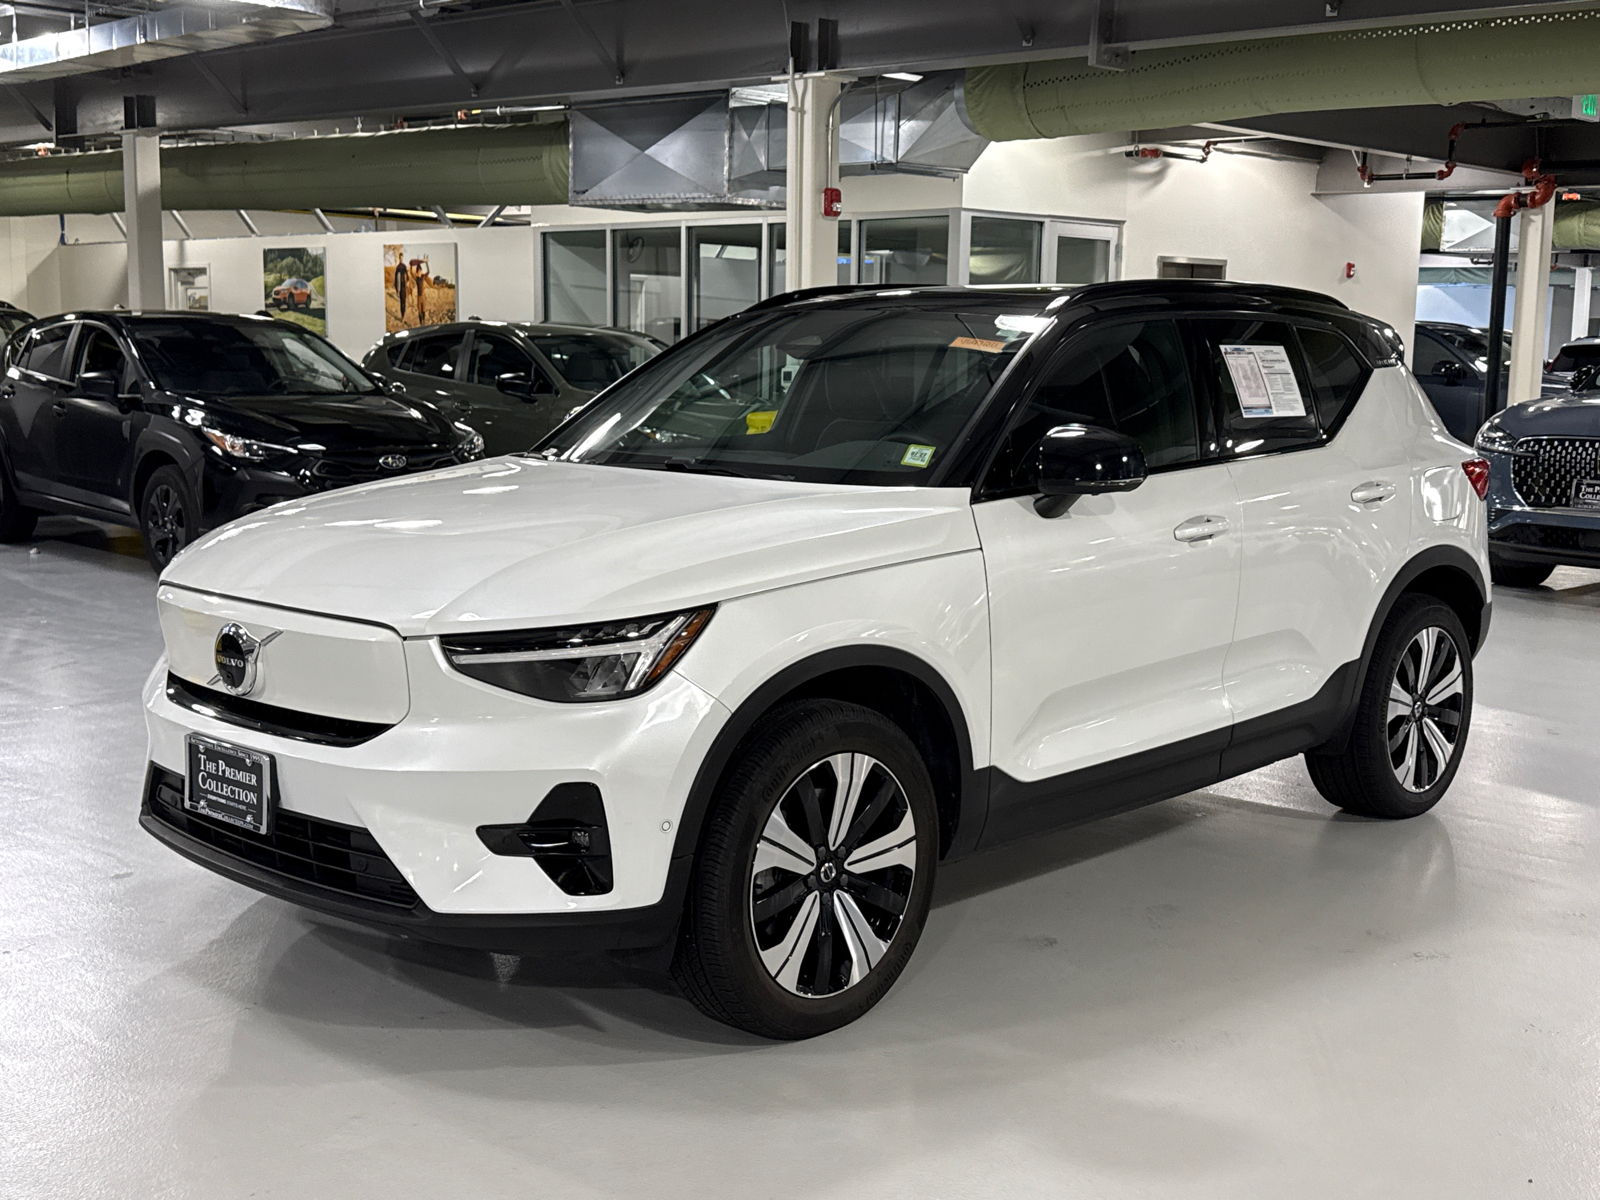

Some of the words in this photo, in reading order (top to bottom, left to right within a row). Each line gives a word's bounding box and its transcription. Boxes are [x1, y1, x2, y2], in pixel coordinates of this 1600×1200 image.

[217, 654, 244, 668] VOLVO
[198, 754, 217, 774] THE
[218, 760, 257, 786] PREMIER
[198, 771, 258, 805] COLLECTION
